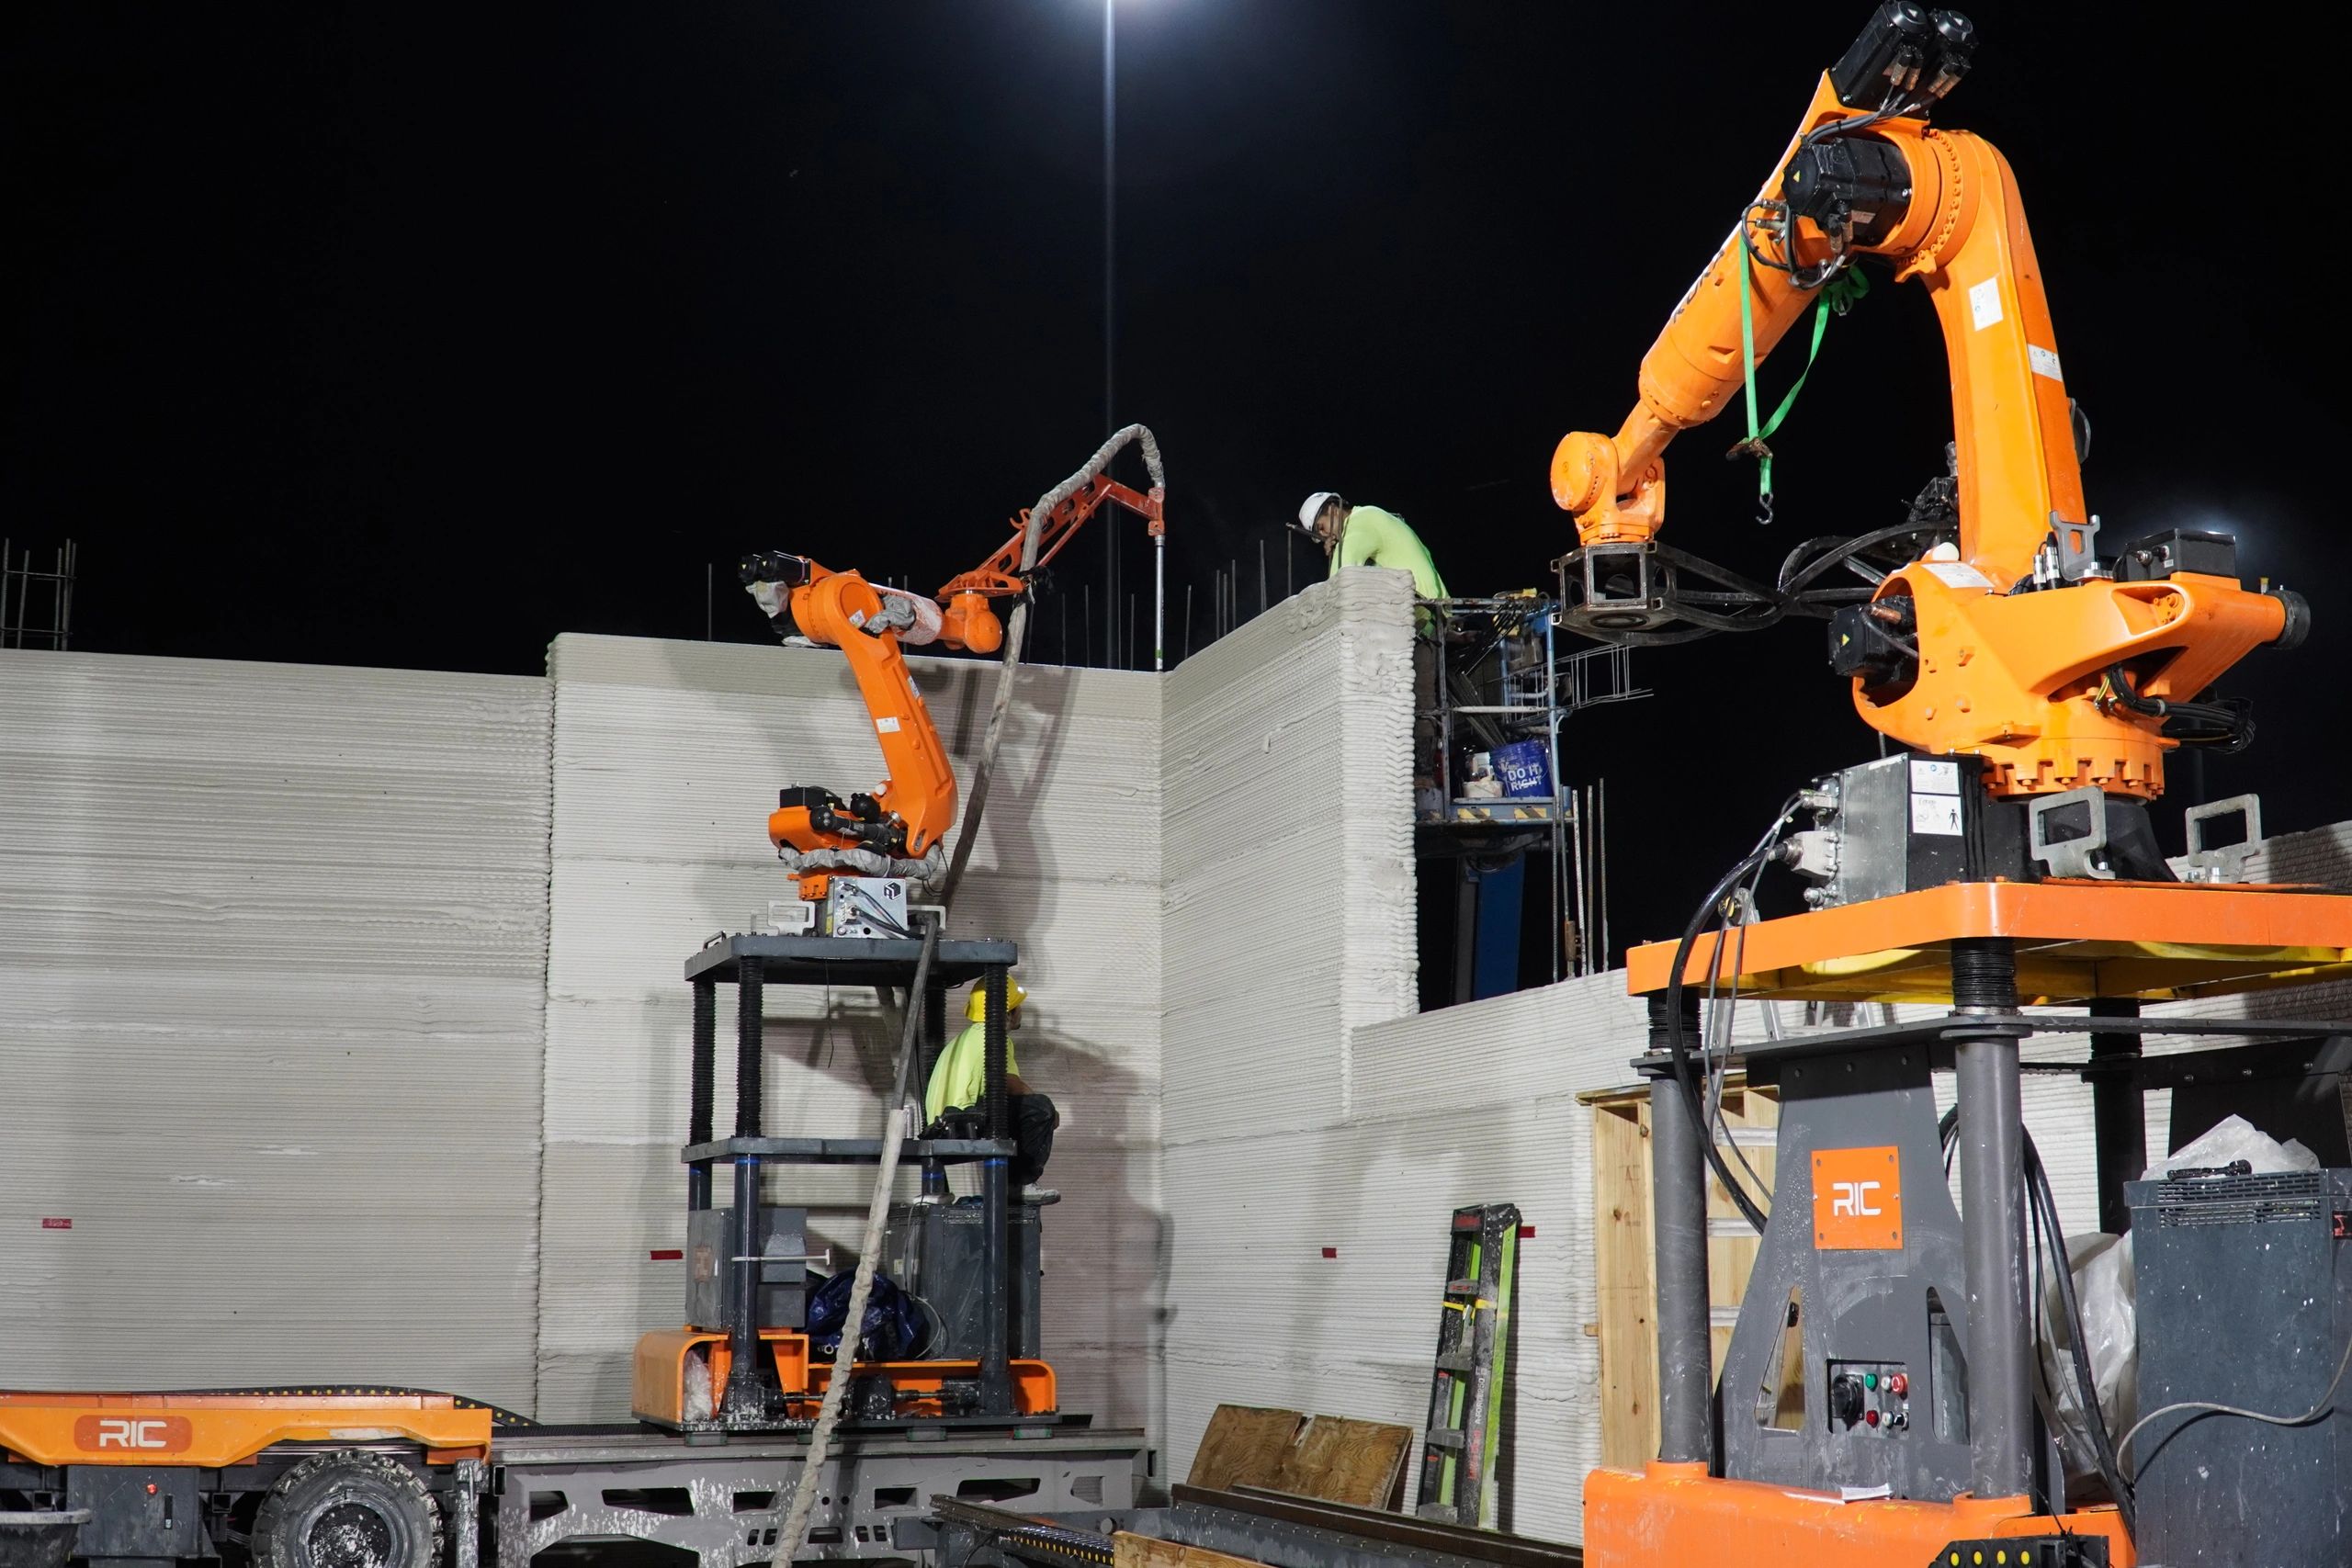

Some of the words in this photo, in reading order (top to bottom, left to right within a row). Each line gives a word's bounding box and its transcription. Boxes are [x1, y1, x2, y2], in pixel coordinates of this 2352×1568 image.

[1508, 768, 1526, 782] DO
[1529, 763, 1540, 776] IT
[1510, 775, 1542, 791] RIGHT
[1832, 1180, 1882, 1217] RIC
[98, 1419, 167, 1448] RIC
